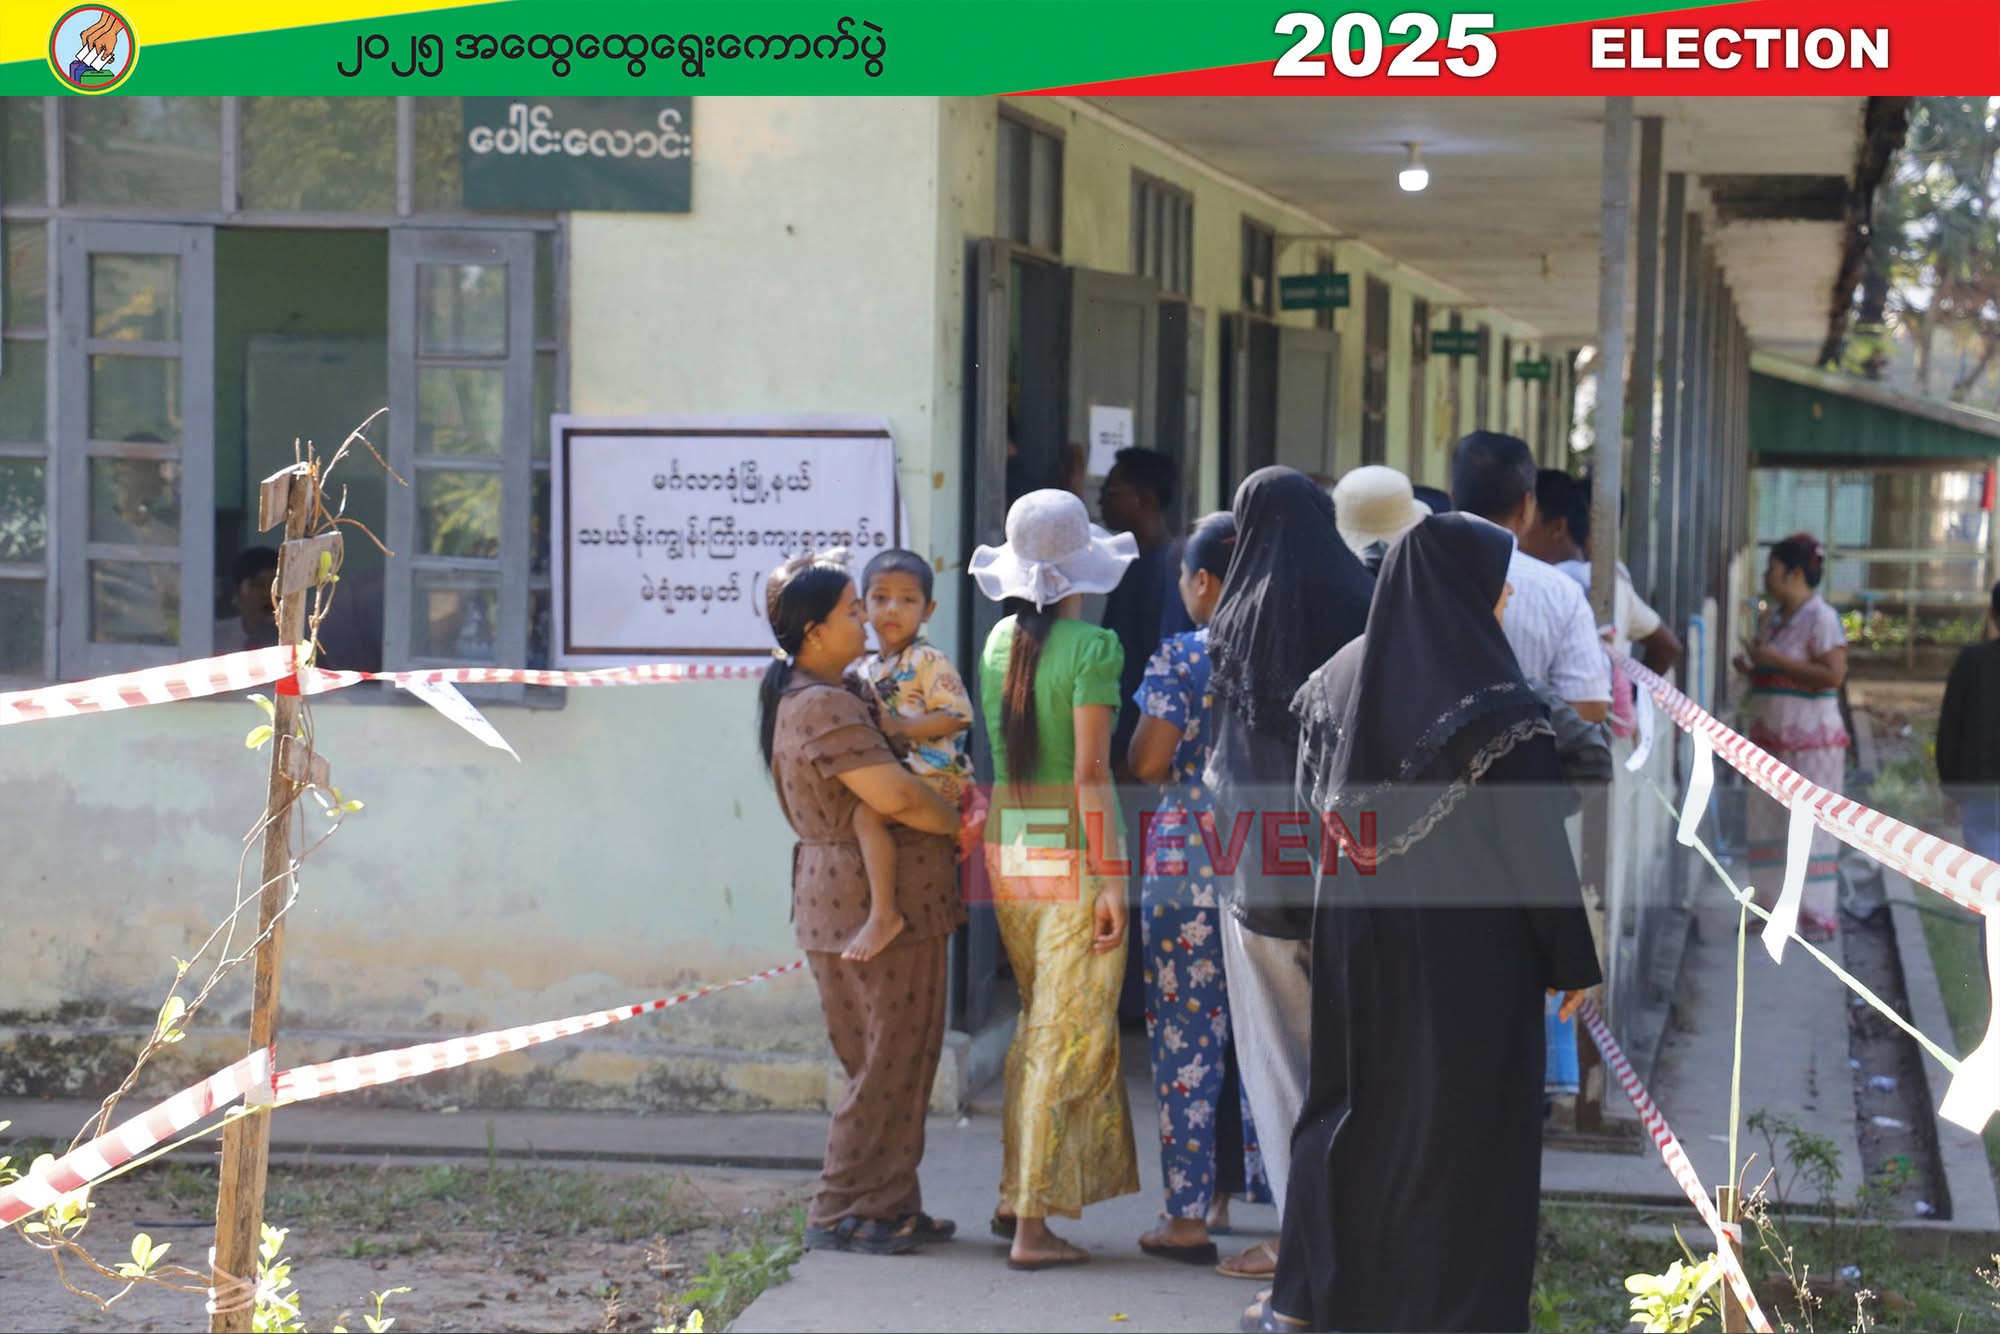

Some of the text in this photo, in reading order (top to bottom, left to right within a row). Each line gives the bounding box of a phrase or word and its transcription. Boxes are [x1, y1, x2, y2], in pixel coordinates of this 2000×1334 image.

[468, 103, 692, 160] ပေါင်းလောင်း
